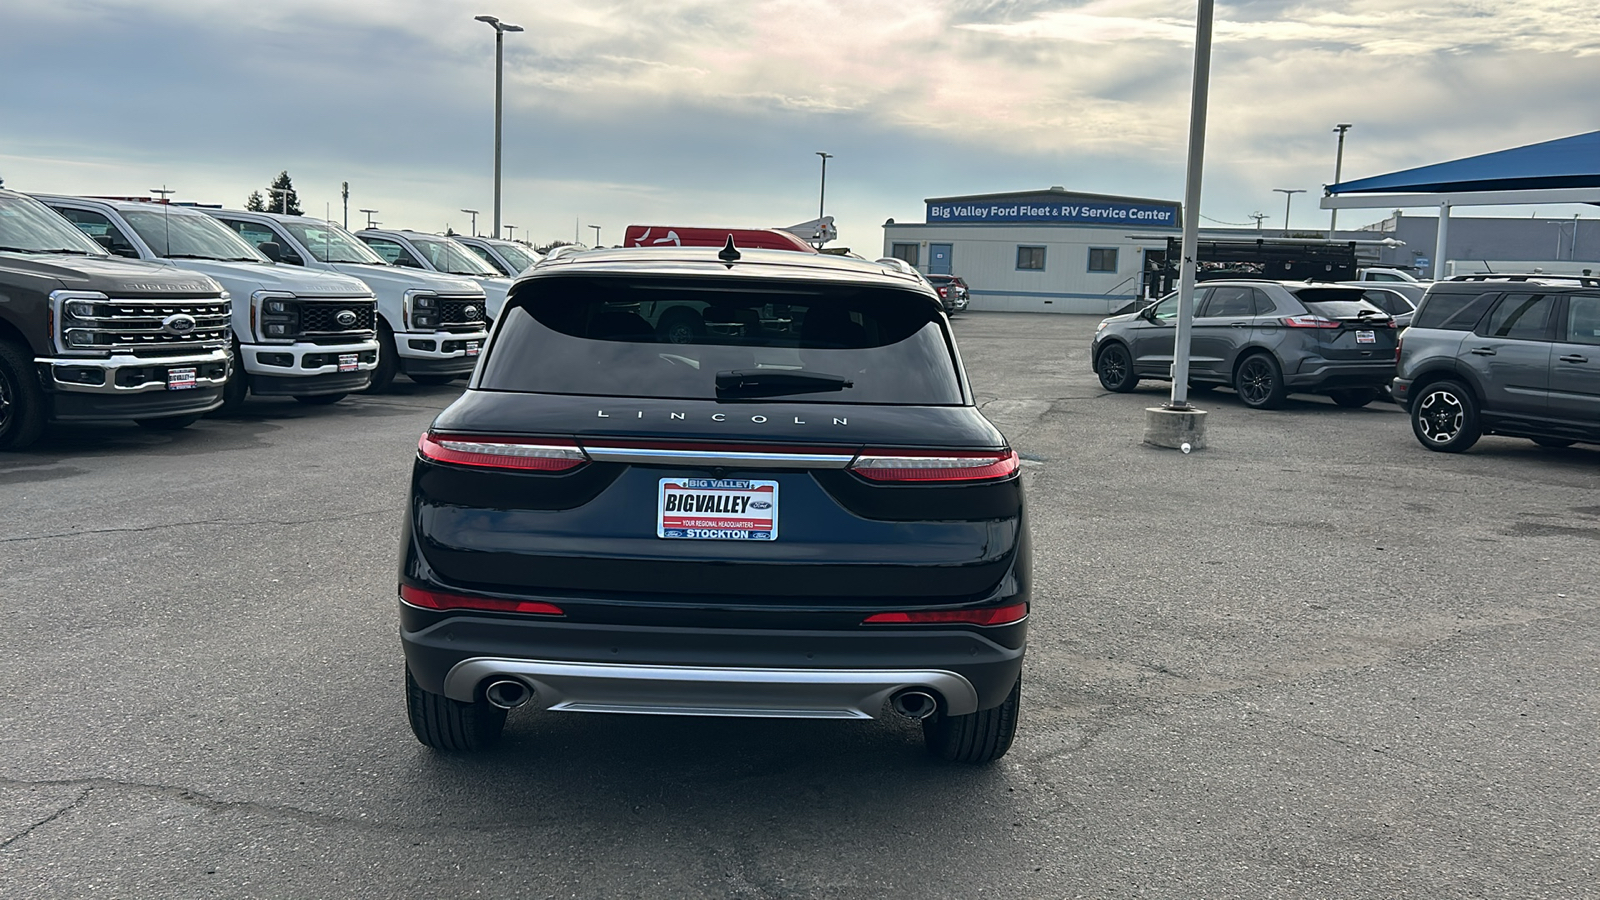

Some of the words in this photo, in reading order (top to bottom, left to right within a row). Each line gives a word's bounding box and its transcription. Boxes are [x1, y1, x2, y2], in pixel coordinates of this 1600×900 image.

[931, 206, 950, 218] Big
[953, 206, 988, 218] Valley
[991, 206, 1017, 216] Ford
[1020, 206, 1050, 216] Fleet
[1052, 208, 1059, 216] &
[1061, 206, 1079, 216] RV
[1081, 207, 1126, 218] Service
[1129, 208, 1171, 220] Center
[597, 410, 848, 425] LINCOLN
[711, 480, 749, 488] VALLEY
[665, 494, 751, 513] BIGVALLEY
[752, 501, 769, 509] Ford
[686, 529, 749, 539] STOCKTON
